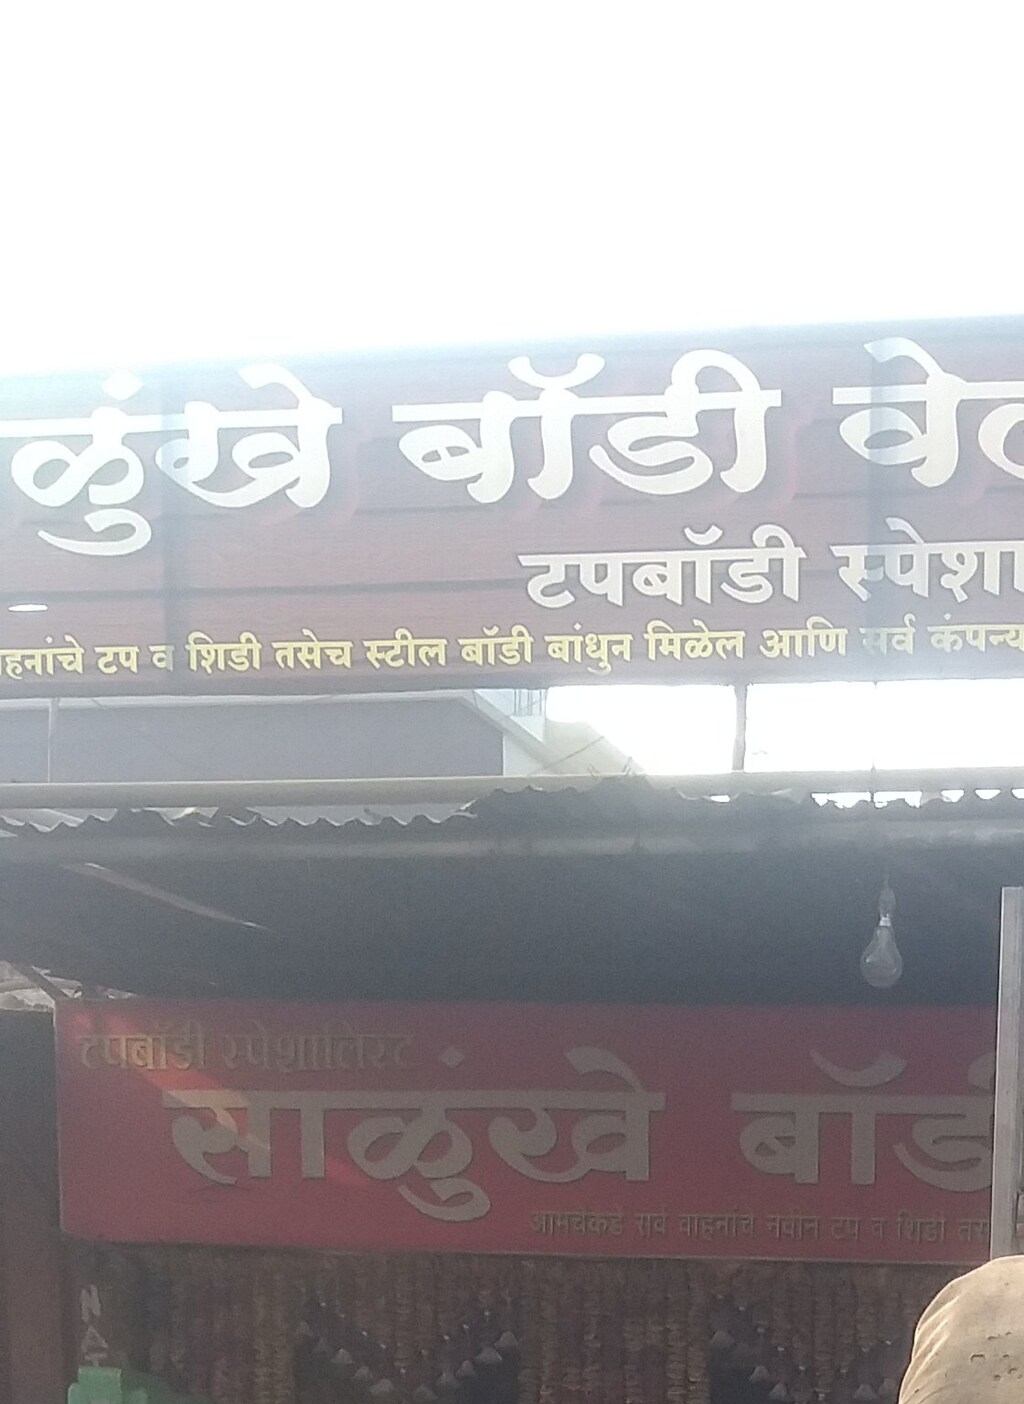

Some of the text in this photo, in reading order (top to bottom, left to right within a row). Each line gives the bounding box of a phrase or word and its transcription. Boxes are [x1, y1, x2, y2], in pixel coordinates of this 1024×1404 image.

[392, 349, 782, 503] बॉडी
[520, 523, 806, 608] टपबॉडी
[0, 634, 84, 680] हनांचे
[95, 645, 140, 674] टप
[149, 645, 175, 672] व
[186, 631, 261, 675] शिडी
[272, 629, 353, 670] तसेच
[363, 628, 447, 669] स्टील
[458, 625, 533, 665] बॉडी
[545, 622, 633, 675] बांधुन
[644, 619, 746, 661] मिळेल
[760, 616, 848, 658] आणि
[859, 613, 916, 656] सर्व
[161, 1046, 667, 1223] साळुंखे
